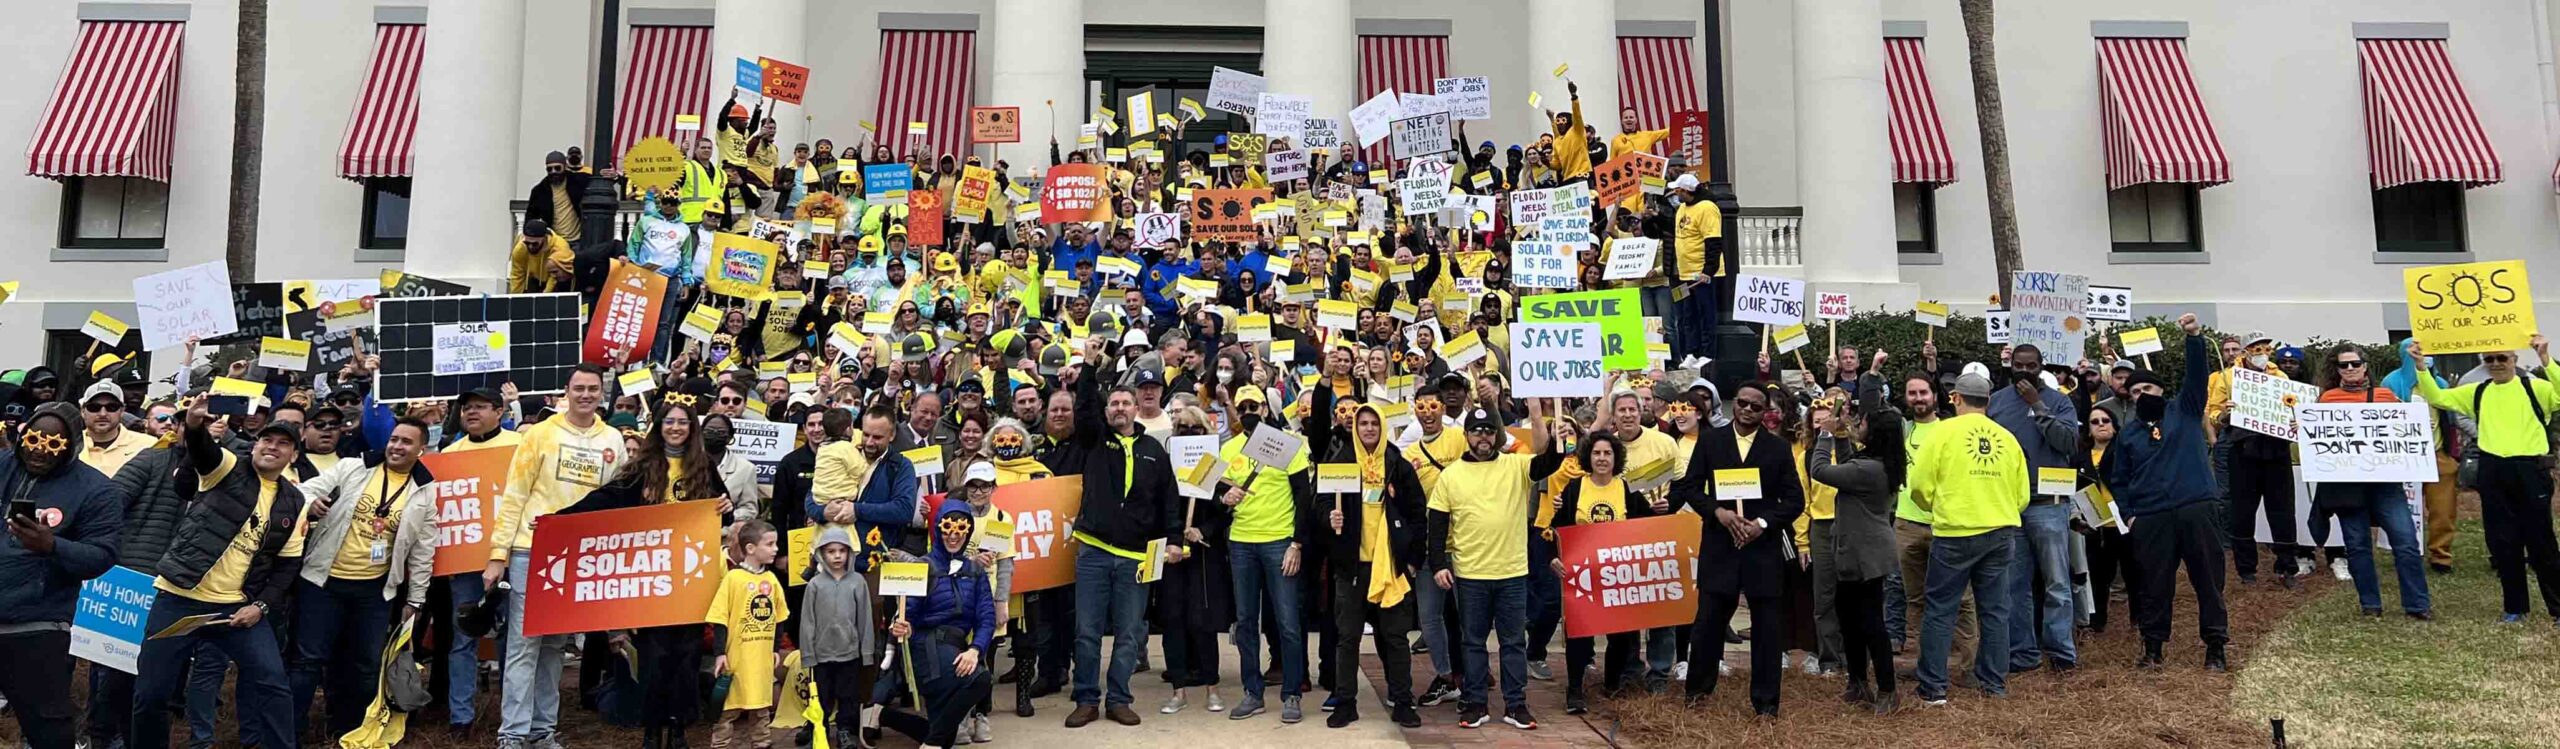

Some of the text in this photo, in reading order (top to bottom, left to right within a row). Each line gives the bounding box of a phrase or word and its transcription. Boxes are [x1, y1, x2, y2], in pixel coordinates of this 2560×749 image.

[773, 67, 802, 80] SAVE
[773, 78, 797, 89] OUR
[1437, 79, 1458, 87] DONT
[763, 85, 800, 101] SOLAR
[1216, 99, 1256, 116] ENERGY
[1304, 119, 1327, 130] SALVA
[1407, 117, 1432, 130] NET
[1401, 127, 1443, 142] METERING
[1229, 134, 1264, 152] SOS
[1303, 137, 1338, 148] SOLAR
[1408, 140, 1441, 154] MATTERS
[1692, 125, 1703, 166] SOLAR
[635, 156, 652, 164] SAVE
[1274, 151, 1302, 162] OPPOSE
[630, 166, 655, 174] SOLAR
[1056, 176, 1096, 186] OPPOSE
[1331, 182, 1346, 190] SAVE
[1404, 177, 1442, 190] FLORIDA
[1056, 188, 1095, 199] SB 1024
[1414, 190, 1442, 201] NEEDS
[1555, 187, 1578, 201] DON'T
[1521, 203, 1546, 212] NEEDS
[1552, 200, 1575, 214] STEAL
[1576, 197, 1590, 208] OUR
[1196, 225, 1264, 233] SAVE OUR SOLA
[1543, 218, 1587, 230] SAVE SOLAR
[1543, 232, 1589, 242] IN FLORIDA
[1518, 242, 1552, 255] SOLAR
[1525, 257, 1562, 270] IS FOR
[155, 277, 193, 298] SAVE
[1515, 273, 1576, 288] THE PEOPLE
[1749, 277, 1790, 297] SAVE
[2014, 271, 2060, 293] SORRY
[2065, 284, 2084, 293] THE
[2417, 268, 2516, 313] SOS
[166, 299, 192, 311] OUR
[1820, 293, 1847, 305] SAVE
[2012, 294, 2086, 314] INCONVENIENCE
[602, 288, 623, 341] PROTECT
[1531, 299, 1621, 319] SAVE
[1738, 296, 1802, 318] OUR JOBS
[1819, 305, 1848, 316] SOLAR
[157, 309, 213, 332] SOLAR
[614, 292, 637, 344] SOLAR
[626, 295, 648, 348] RIGHTS
[2040, 315, 2055, 323] are
[2417, 313, 2519, 331] SAVE OUR SOLAR
[459, 323, 496, 333] SOLAR
[2016, 323, 2046, 340] trying
[2051, 326, 2062, 339] to
[1521, 328, 1584, 349] SAVE
[2042, 352, 2068, 364] RLD!
[1519, 360, 1602, 382] OUR JOBS
[2234, 368, 2319, 397] KEEP SOLAR
[2234, 381, 2269, 396] JOBS
[2241, 393, 2290, 414] BUSINE
[2234, 403, 2290, 425] AND ENE
[2302, 409, 2352, 421] STICK
[733, 421, 779, 431] TERPIECE
[2243, 418, 2298, 440] FREEDO
[2303, 423, 2422, 439] WHERE THE SUN
[997, 447, 1019, 456] VOTE
[2309, 439, 2367, 455] DON'T
[561, 460, 600, 474] GEOGRAPHIC
[570, 455, 596, 464] NATIONAL
[2316, 455, 2357, 472] SAVE
[578, 529, 673, 553] PROTECT
[1597, 541, 1677, 564] PROTECT
[576, 549, 672, 578] SOLAR
[883, 574, 924, 582] #SaveOurSolar
[1600, 559, 1680, 587] SOLAR
[92, 579, 154, 610] MY HOME
[574, 575, 672, 602] RIGHTS
[1602, 582, 1684, 608] RIGHTS
[81, 597, 138, 628] THE SUN
[752, 607, 771, 618] POWER
